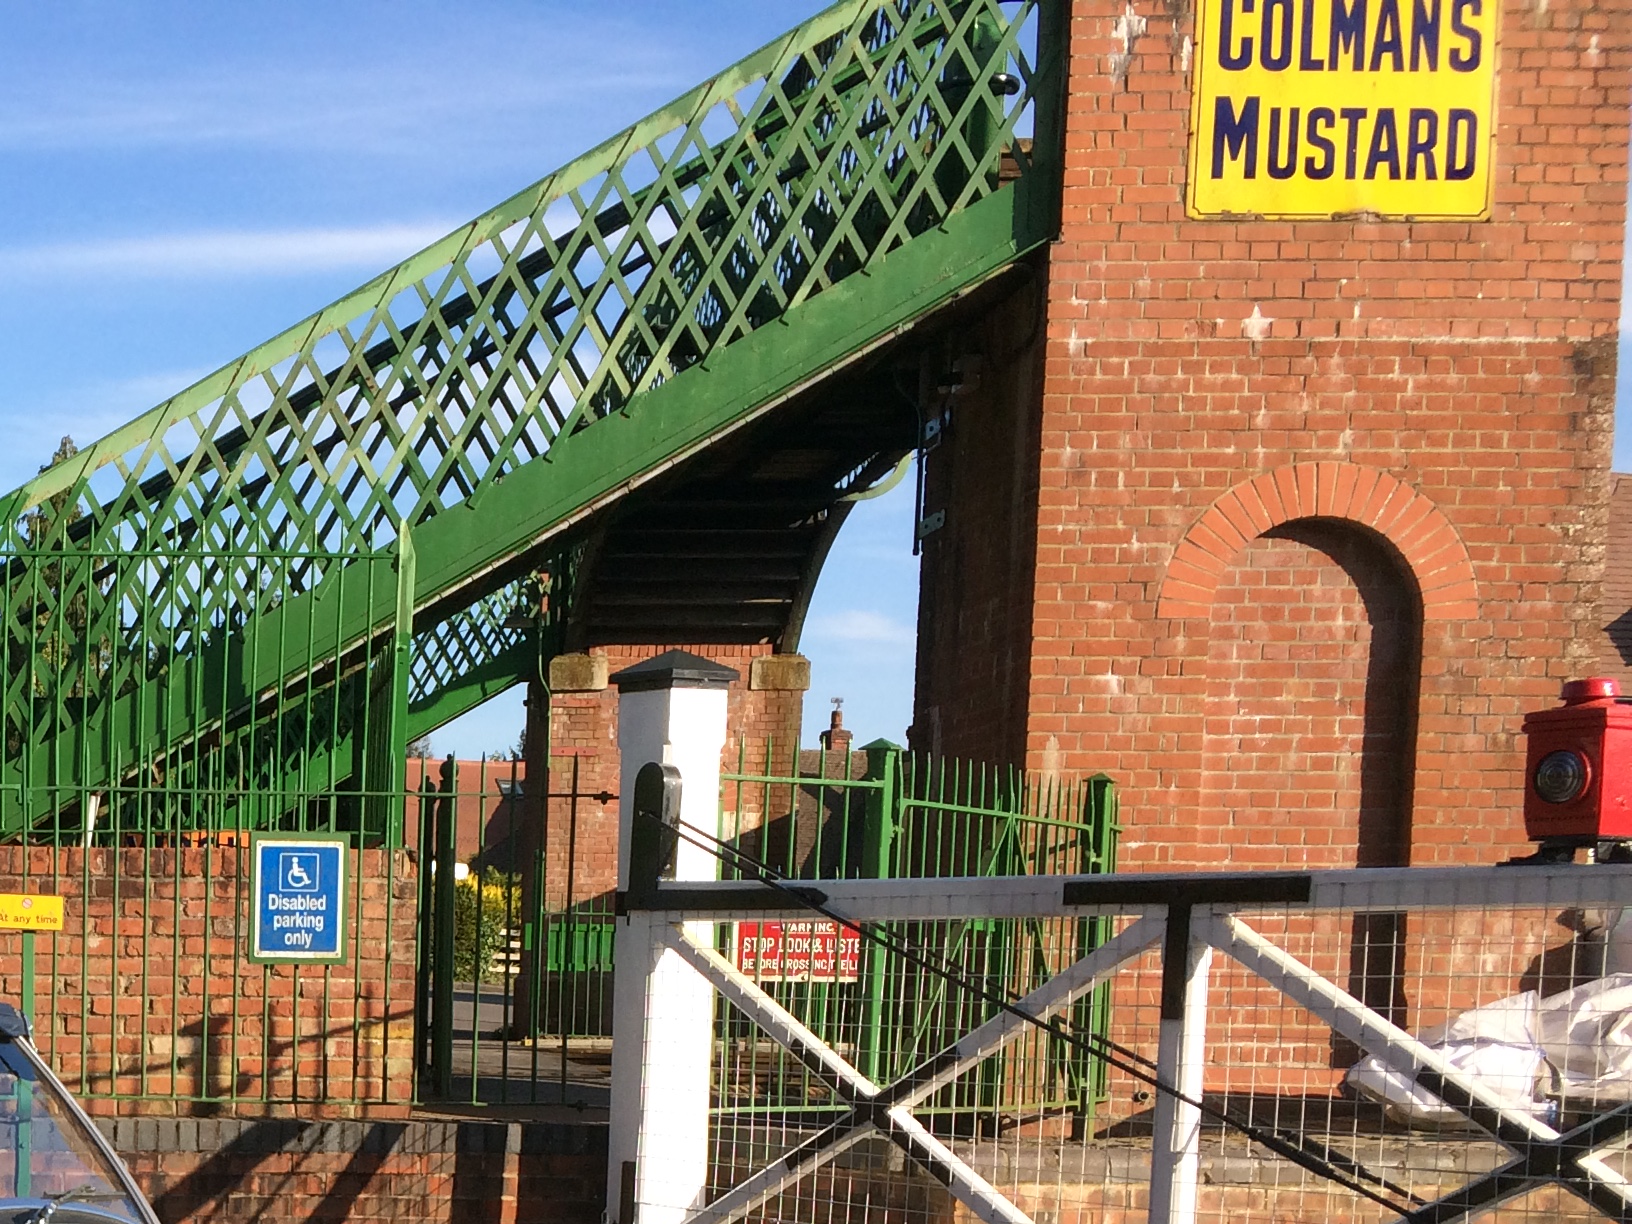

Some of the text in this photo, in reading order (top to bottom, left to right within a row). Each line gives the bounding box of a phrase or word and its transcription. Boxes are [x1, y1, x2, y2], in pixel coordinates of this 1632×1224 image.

[1218, 0, 1482, 72] COLMANS
[1211, 95, 1478, 181] MUSTARD
[268, 893, 327, 911] Disabled
[13, 915, 31, 925] any
[35, 914, 58, 924] time
[273, 912, 324, 932] parking
[284, 929, 313, 949] only
[743, 937, 860, 954] STOP LOOK & LISTE
[742, 958, 779, 970] BEORE
[781, 958, 828, 970] ROSSNG
[828, 959, 848, 971] TE
